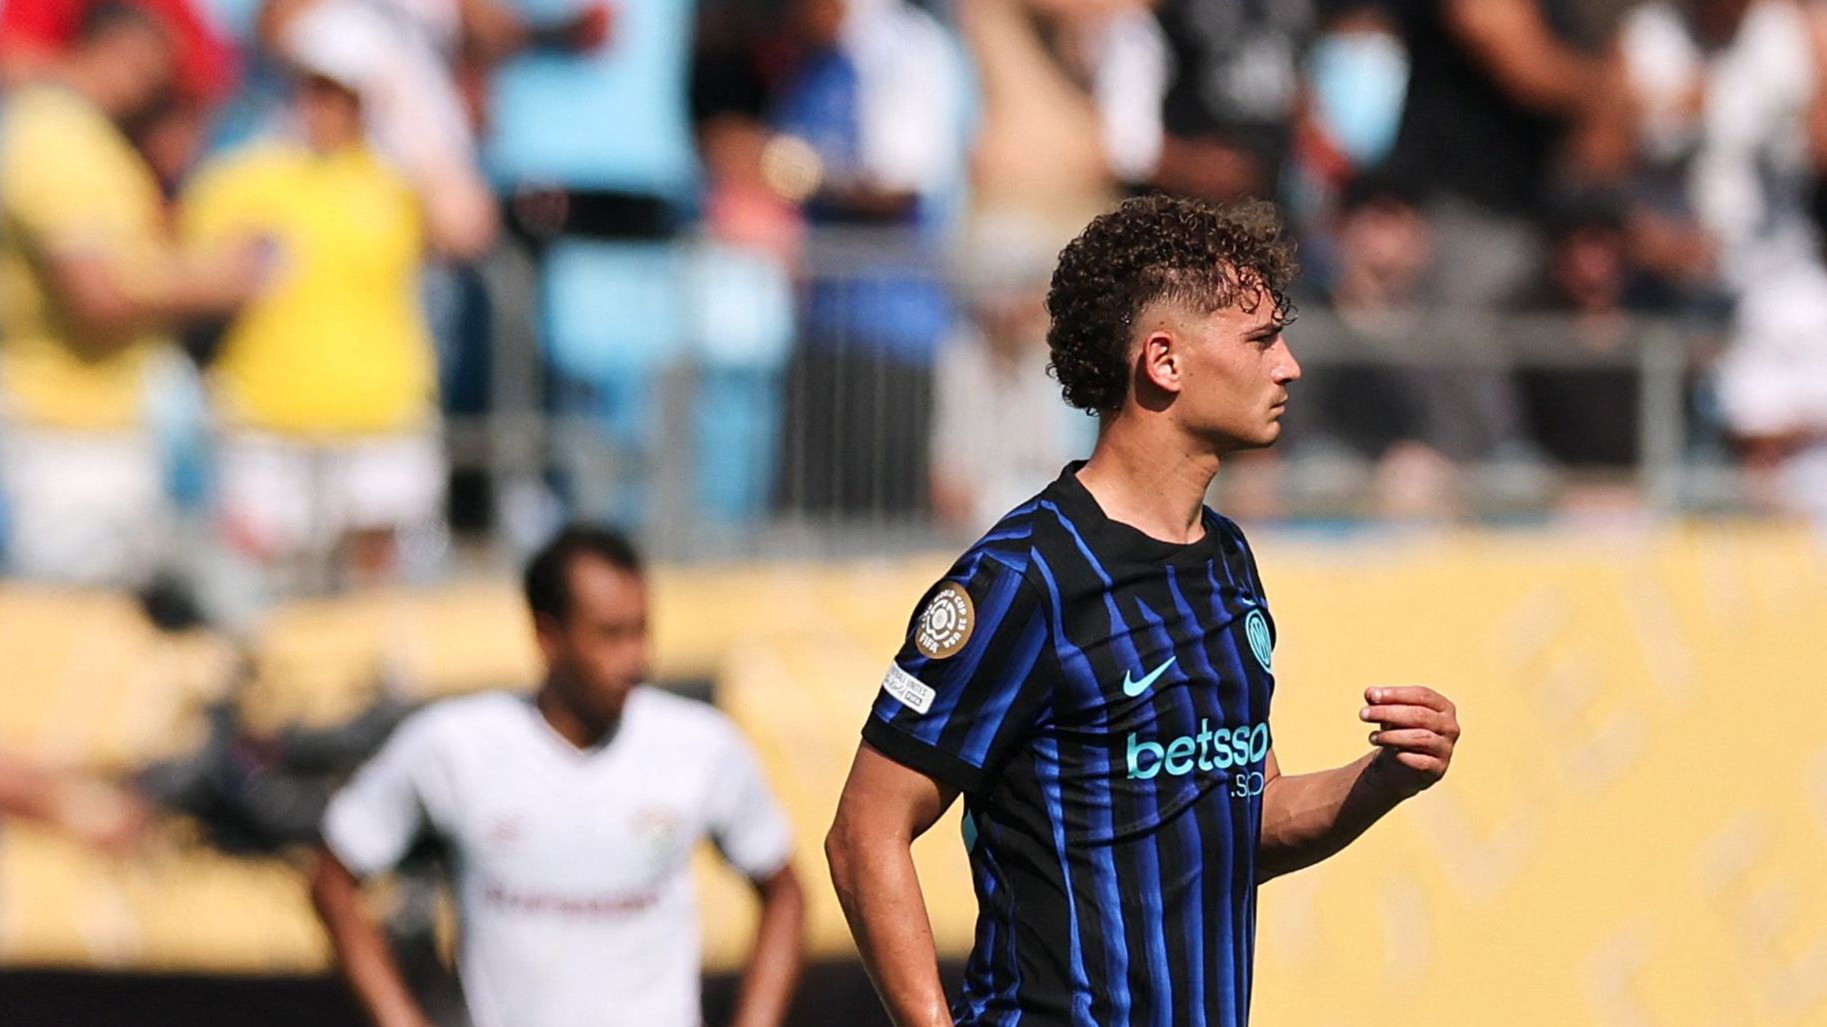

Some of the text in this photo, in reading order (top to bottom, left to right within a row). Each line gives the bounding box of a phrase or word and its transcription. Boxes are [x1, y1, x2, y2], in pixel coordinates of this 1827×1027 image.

[954, 595, 968, 616] CUP
[918, 632, 940, 653] FIFA
[1126, 718, 1268, 780] betsso
